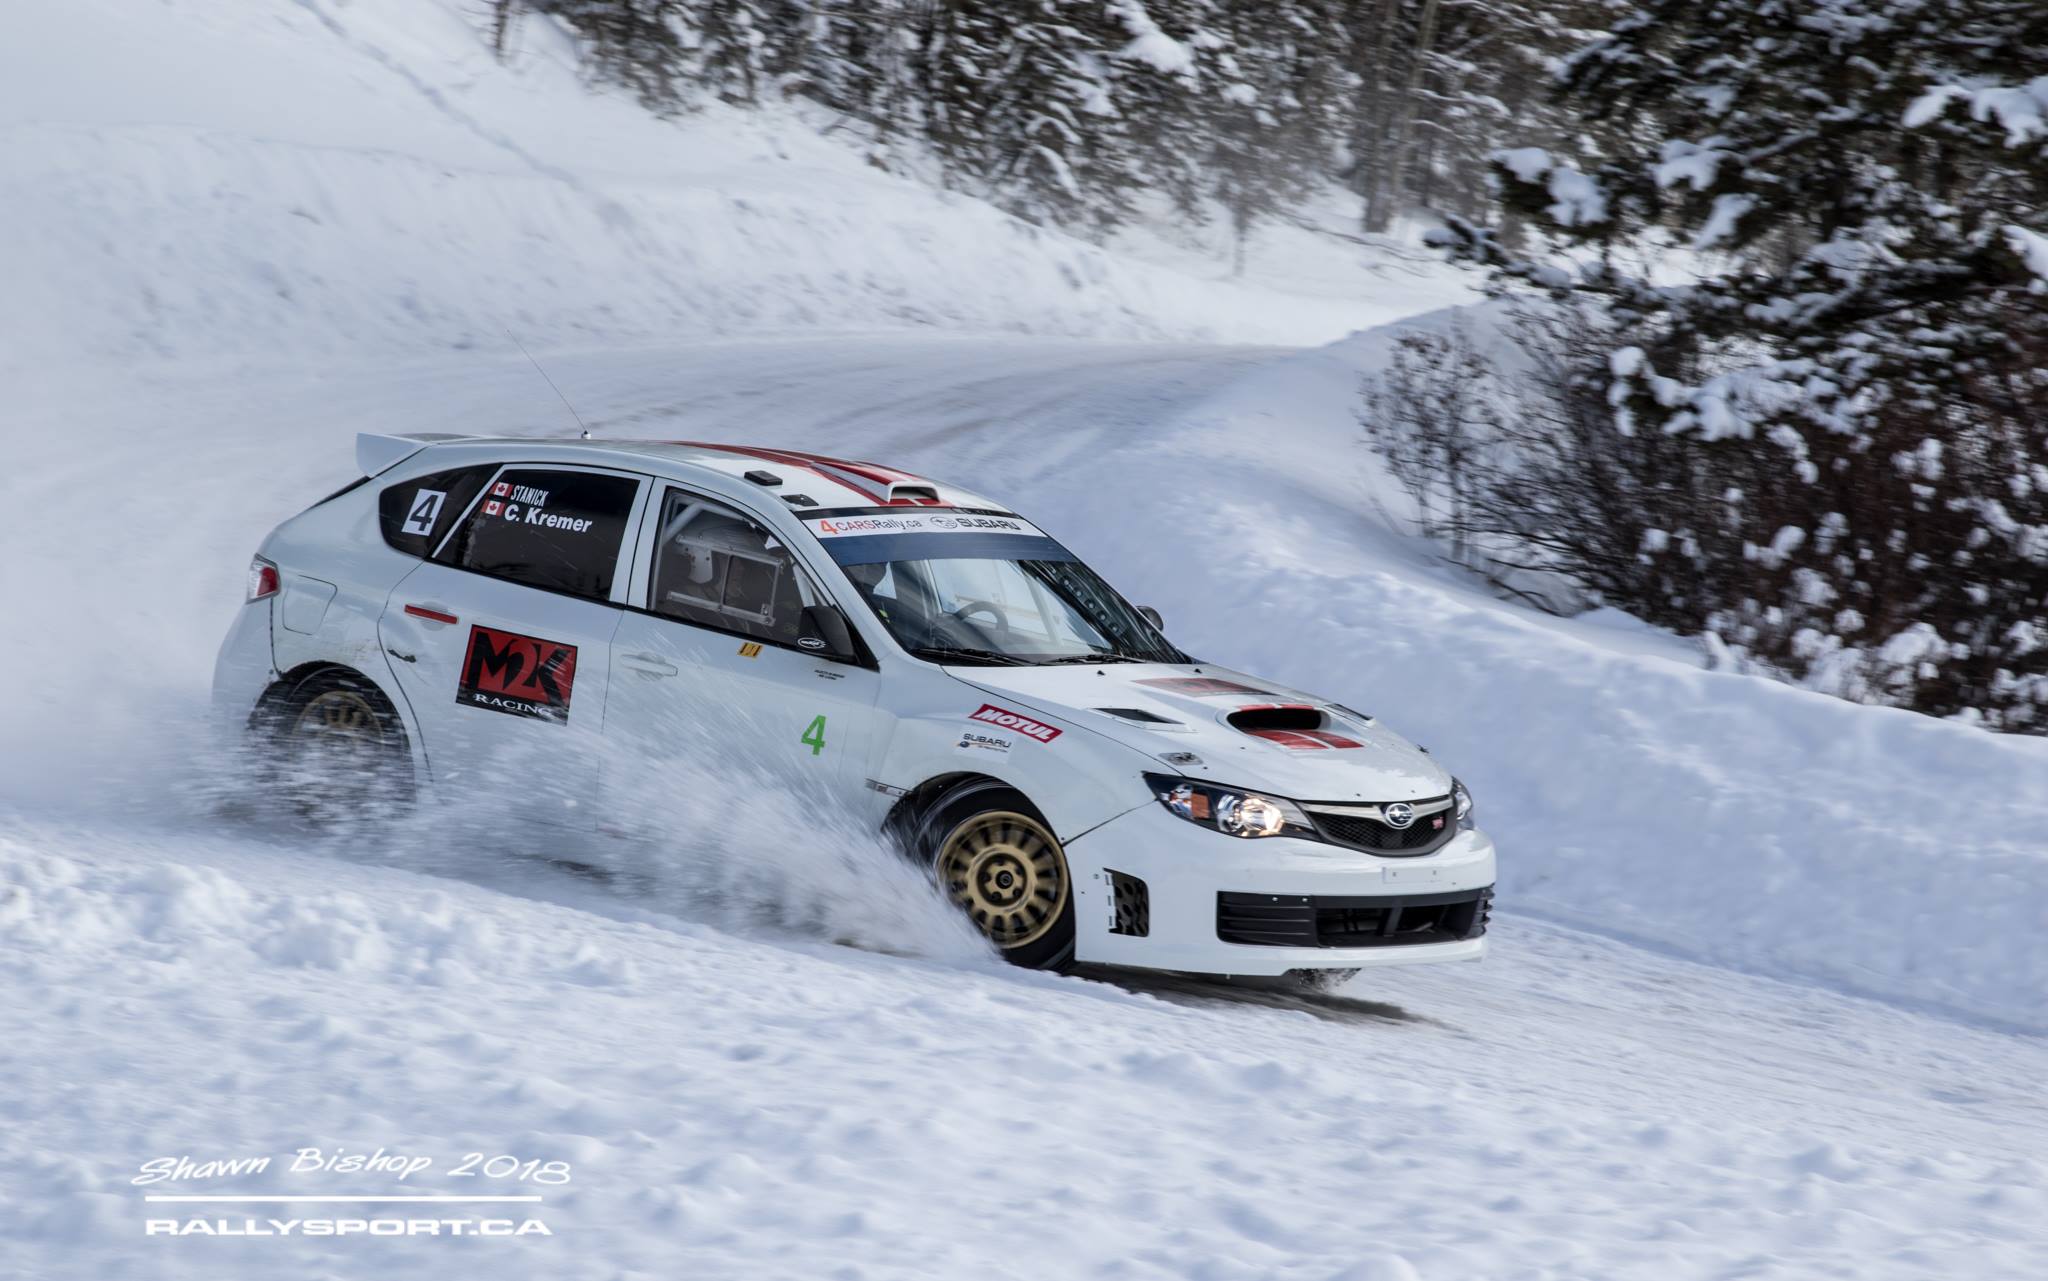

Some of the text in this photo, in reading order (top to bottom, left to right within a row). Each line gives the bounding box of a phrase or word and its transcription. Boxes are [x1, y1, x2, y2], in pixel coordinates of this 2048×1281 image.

[510, 485, 549, 507] STANICK
[409, 494, 439, 532] 4
[504, 503, 593, 533] C. Kremer
[955, 518, 1022, 531] SUBARU
[474, 693, 555, 717] RACING
[801, 714, 827, 756] 4
[976, 708, 1056, 740] MOTUL
[963, 733, 1012, 748] SUBARU
